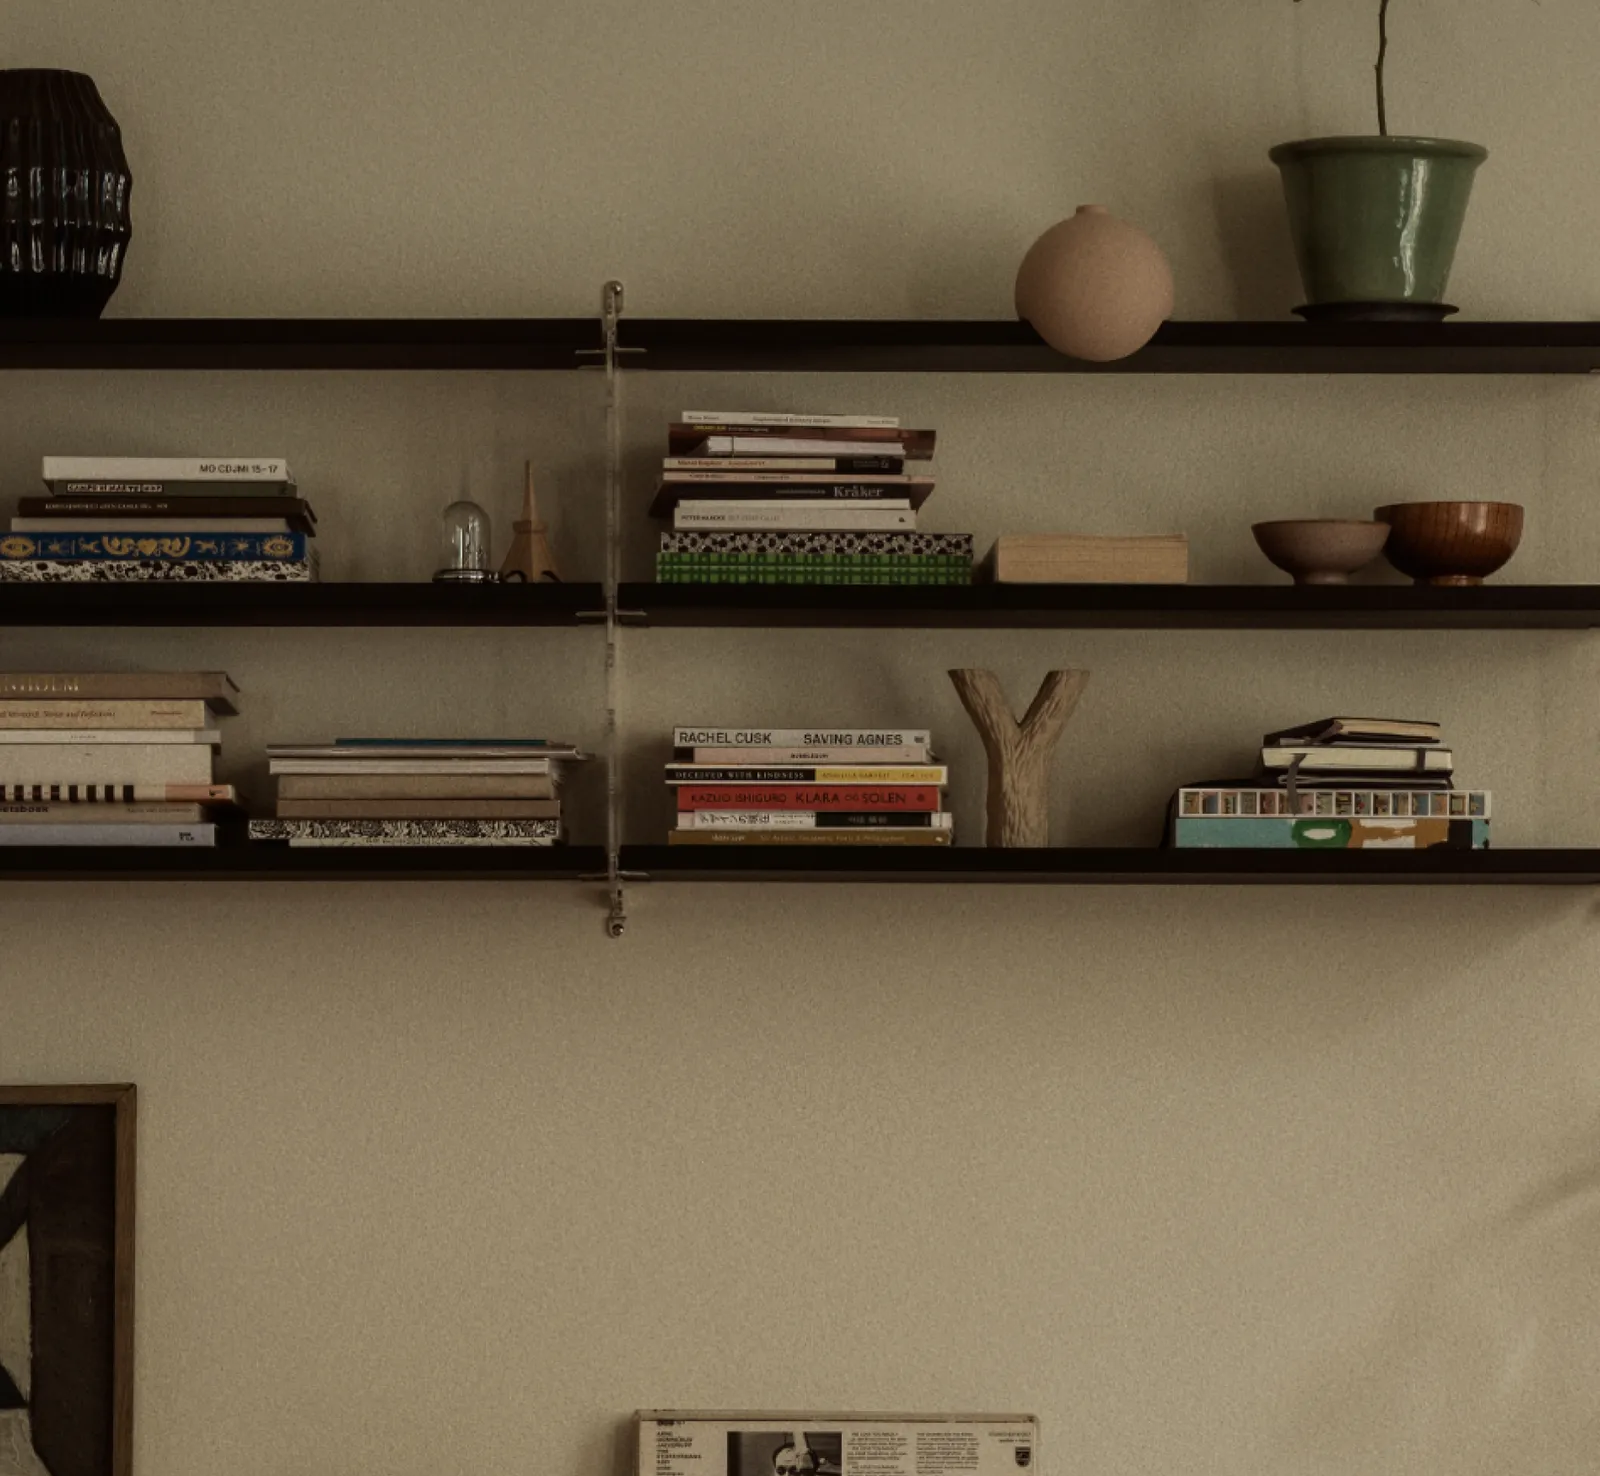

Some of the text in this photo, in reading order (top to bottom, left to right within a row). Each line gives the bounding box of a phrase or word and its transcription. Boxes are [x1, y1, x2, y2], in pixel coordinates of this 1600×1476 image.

[833, 485, 884, 497] Kråker
[679, 732, 903, 745] RACHEL CUSK SAVING AGNES
[691, 793, 730, 803] KAZUO
[734, 793, 787, 803] ISHIGURO
[795, 792, 840, 804] KLARA
[862, 792, 907, 804] SOLEN
